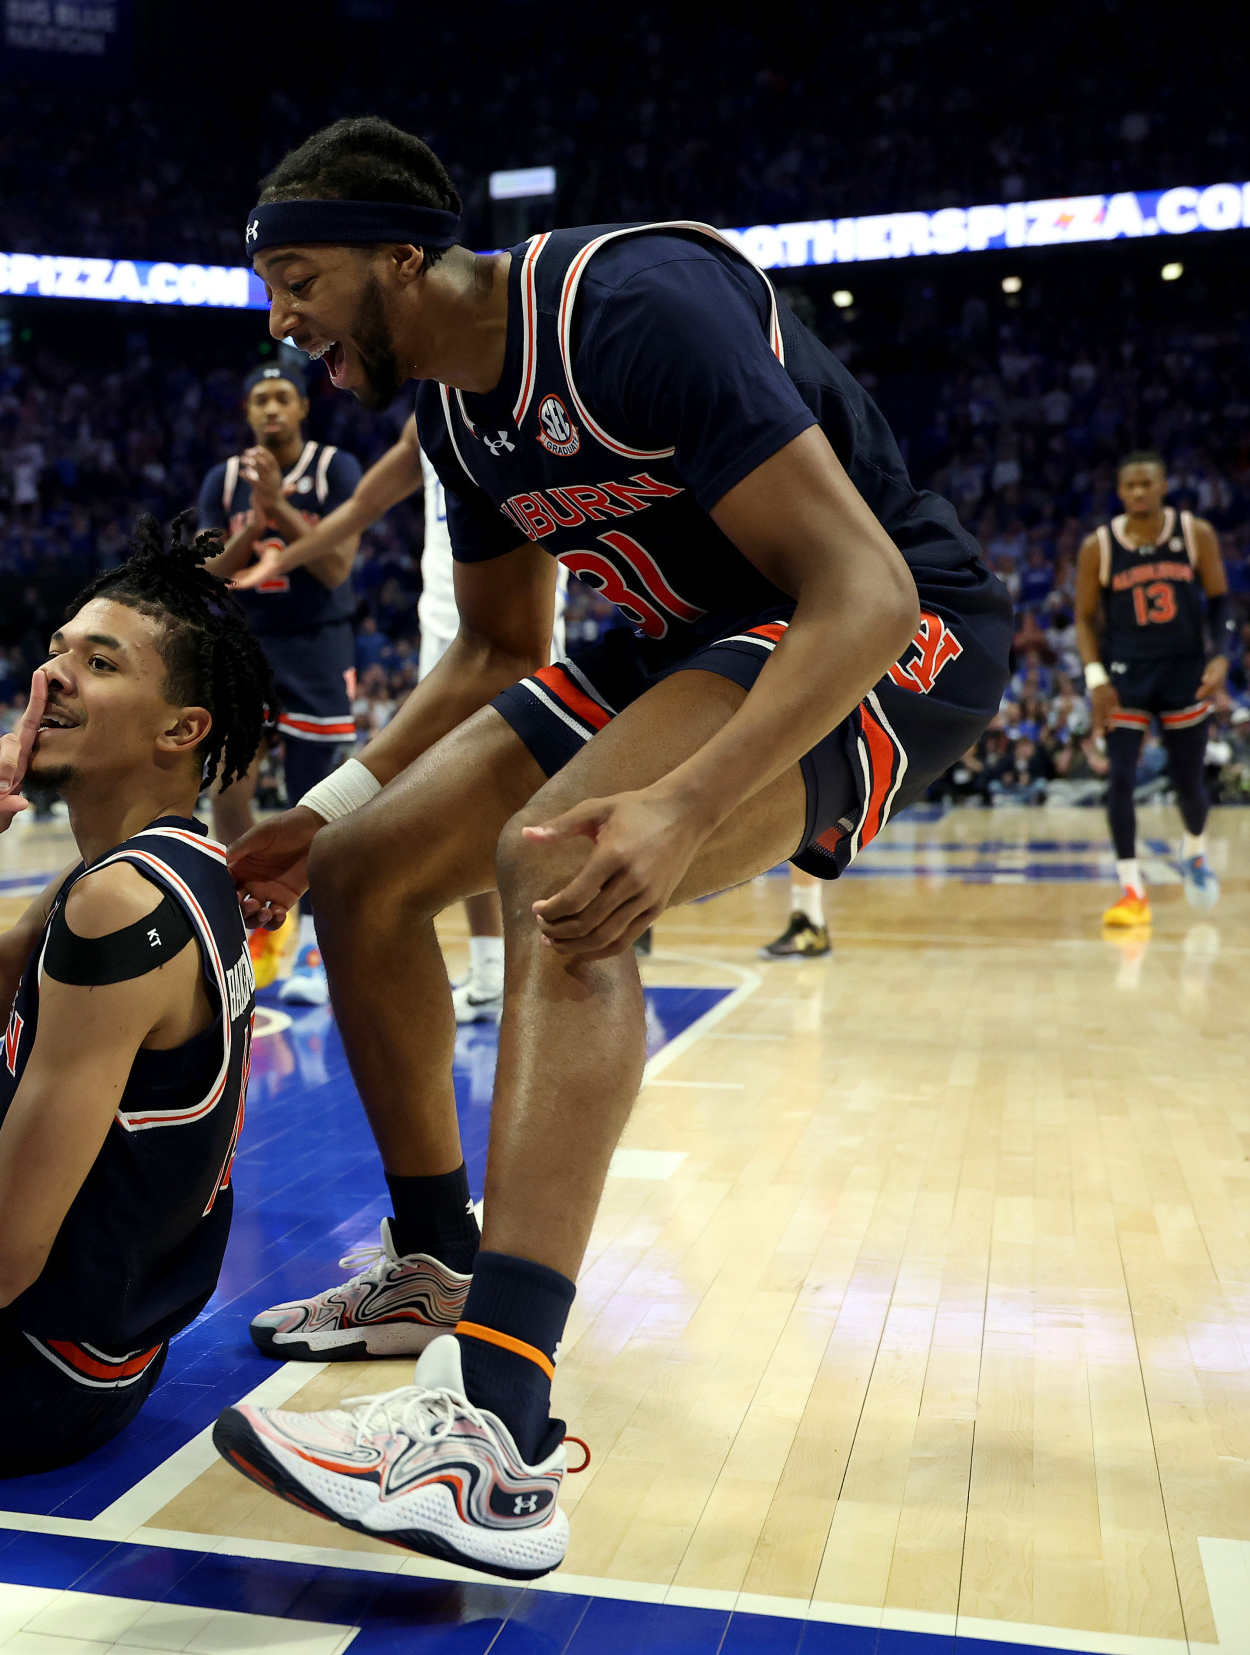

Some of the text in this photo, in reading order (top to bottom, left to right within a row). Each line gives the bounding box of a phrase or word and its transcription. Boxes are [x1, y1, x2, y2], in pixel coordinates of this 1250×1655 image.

[719, 180, 1250, 270] OTHERSPIZZA.CO
[541, 398, 570, 441] SEC
[499, 472, 685, 541] UBURN
[555, 530, 708, 641] 31
[1132, 581, 1178, 627] 13
[146, 928, 162, 947] KT
